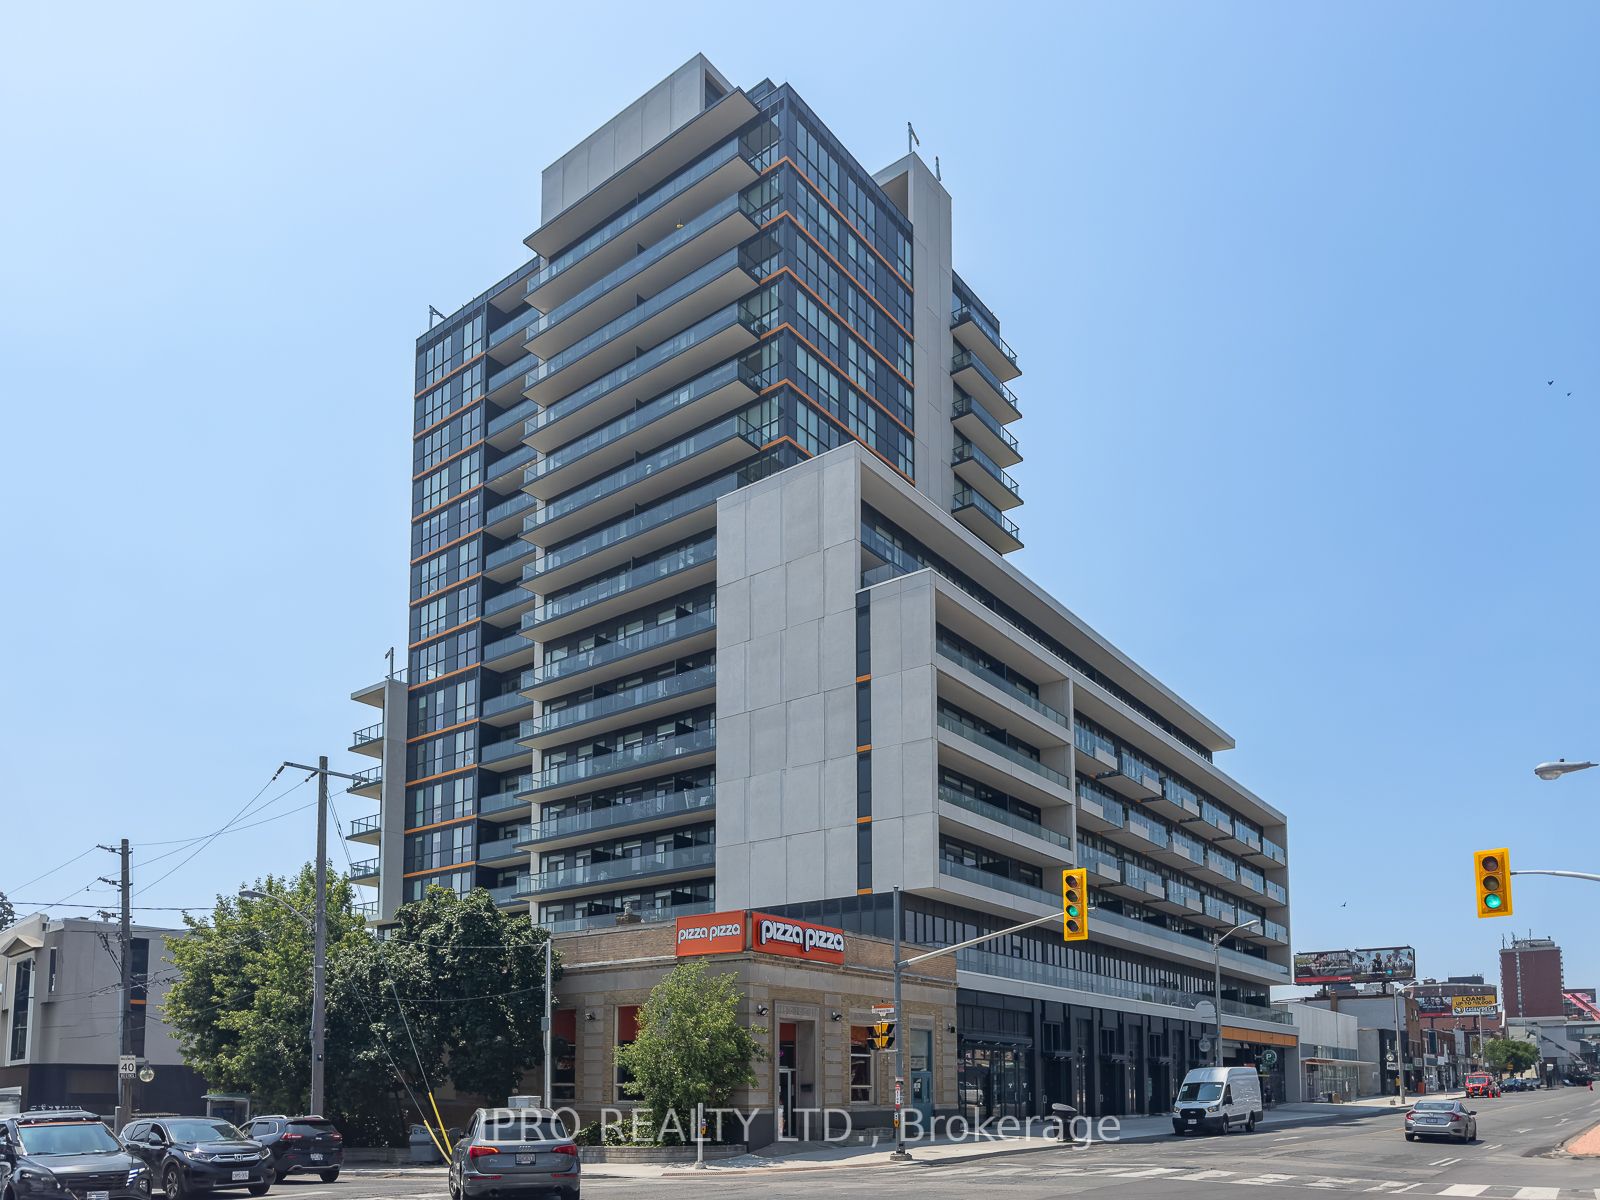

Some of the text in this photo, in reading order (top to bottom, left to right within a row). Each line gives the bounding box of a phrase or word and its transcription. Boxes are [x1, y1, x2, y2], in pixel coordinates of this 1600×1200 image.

[678, 923, 741, 944] pizza pizza
[760, 920, 844, 952] pizza pizza
[121, 1063, 134, 1072] 40
